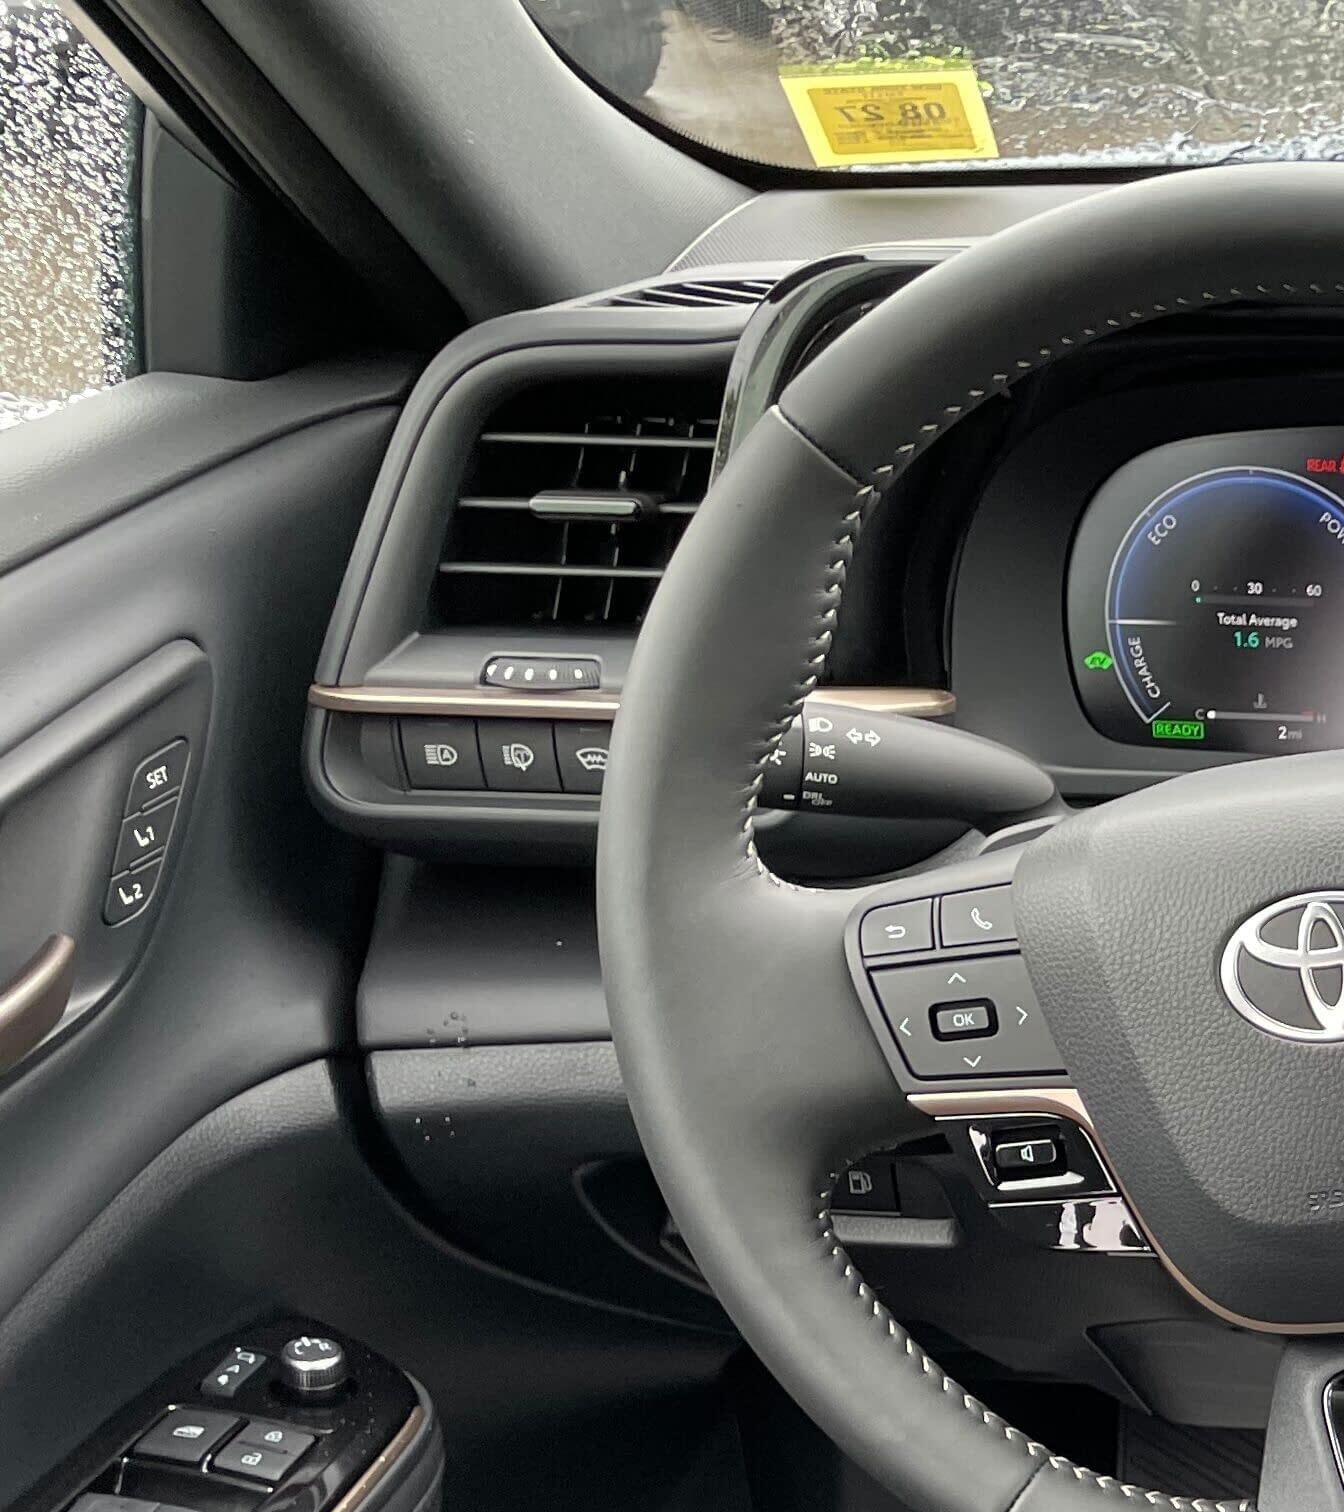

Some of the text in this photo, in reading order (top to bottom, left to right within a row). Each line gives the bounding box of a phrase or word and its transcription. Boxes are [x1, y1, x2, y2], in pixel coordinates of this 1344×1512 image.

[1307, 459, 1336, 473] REAR
[1147, 514, 1177, 545] ECO
[1191, 580, 1322, 597] 0 30 60
[1217, 612, 1298, 630] Total Average
[1234, 631, 1294, 649] 1.6 MPG
[1128, 636, 1161, 699] CHARGE
[1156, 723, 1200, 737] READY
[1278, 726, 1288, 740] 2
[146, 765, 169, 790] SET
[805, 772, 838, 785] AUTO
[952, 1012, 975, 1027] OK
